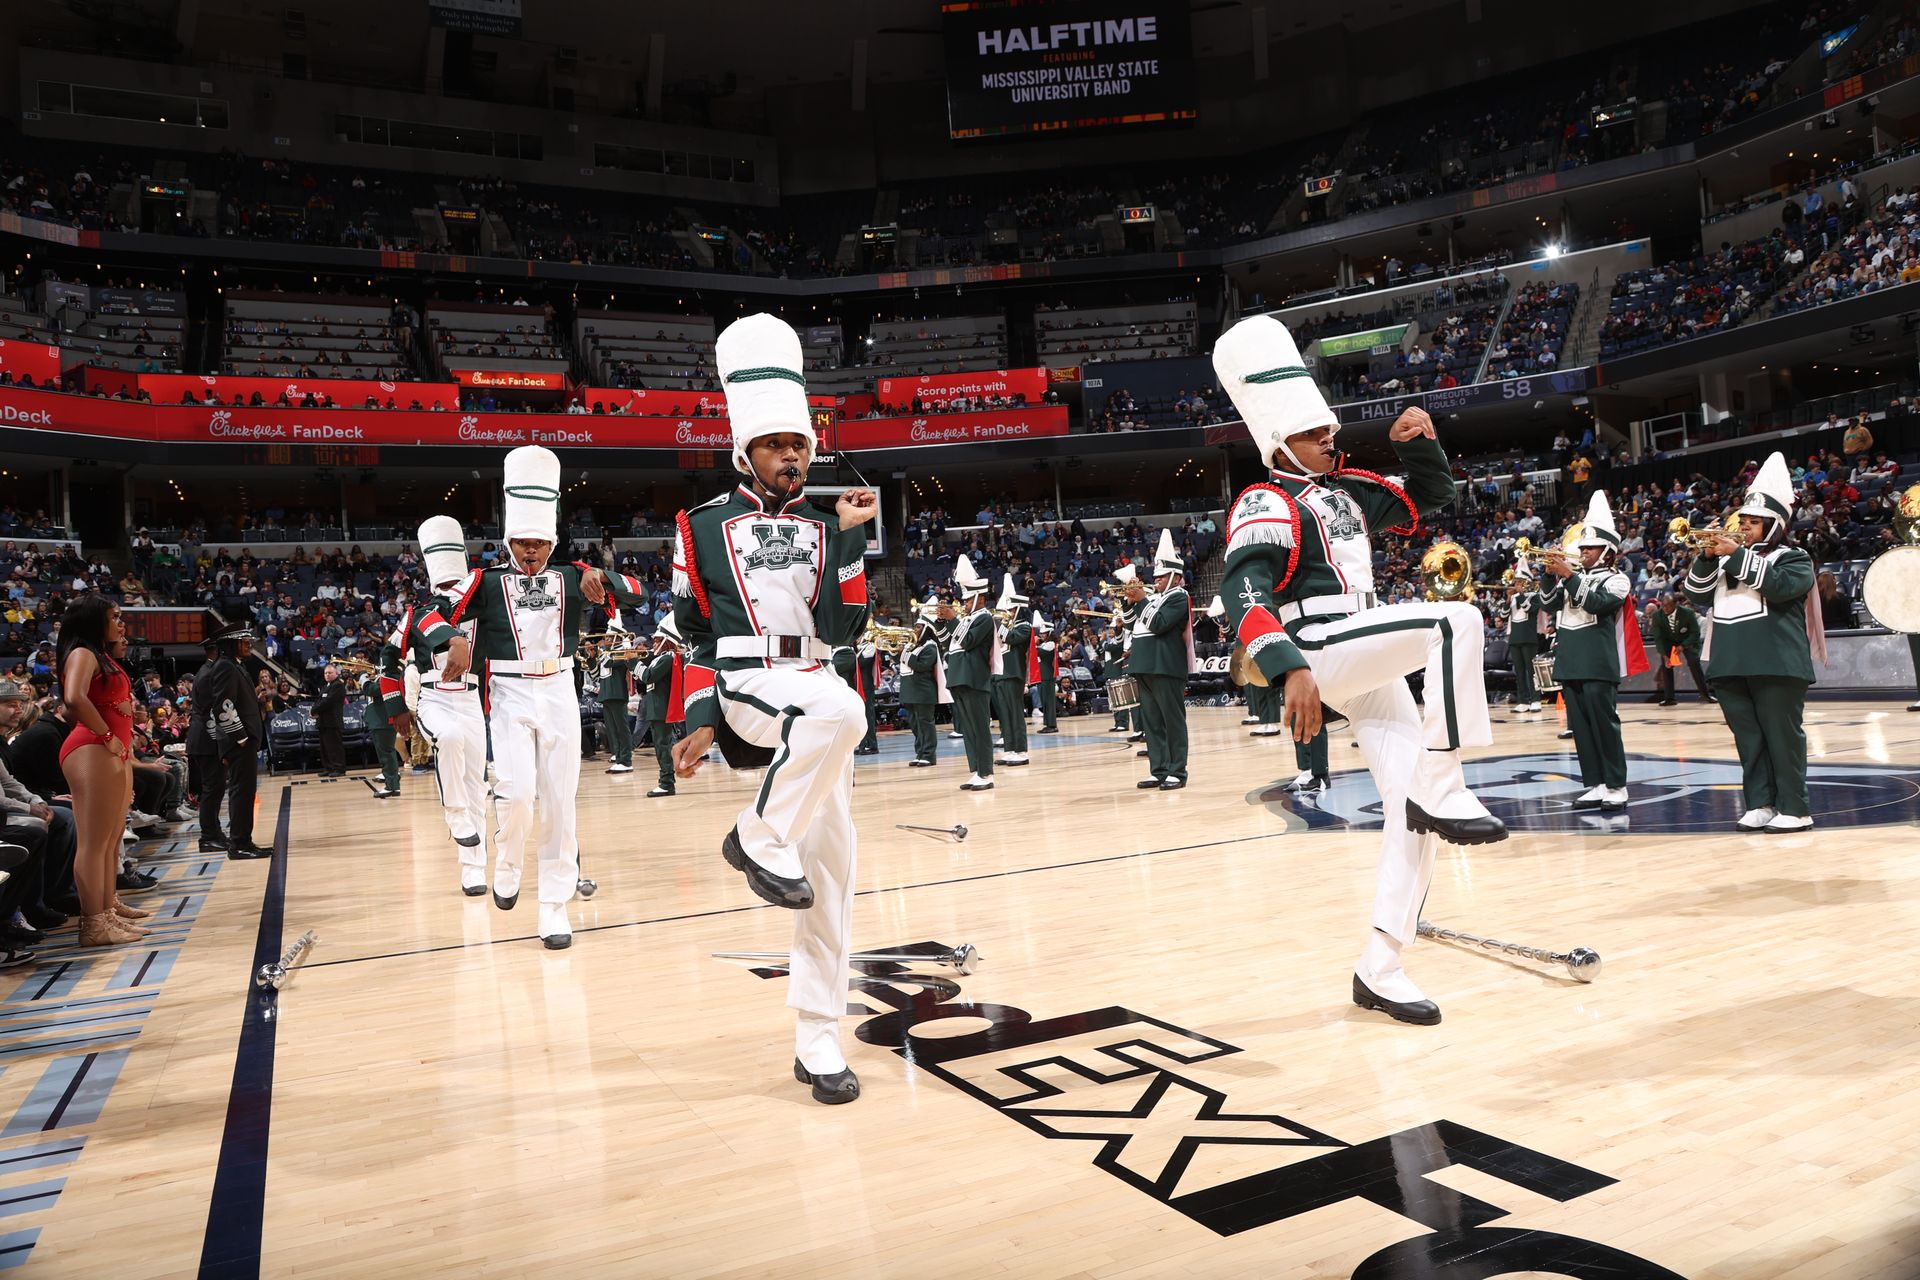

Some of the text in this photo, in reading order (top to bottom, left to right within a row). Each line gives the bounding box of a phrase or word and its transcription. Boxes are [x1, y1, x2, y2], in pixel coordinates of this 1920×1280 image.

[978, 16, 1157, 55] HALFTIME
[1043, 51, 1095, 63] FEATURING
[982, 60, 1159, 88] MISSISSIPPI VALLEY STATE
[1012, 80, 1131, 103] UNIVERSITY BAND
[1334, 331, 1401, 352] OrthoSouth
[508, 377, 546, 386] FanDeck
[917, 382, 1006, 397] Score points with
[1503, 381, 1531, 398] 58
[1428, 388, 1480, 403] TIMEOUTS: 5
[1429, 399, 1458, 410] FOULS:
[0, 405, 52, 425] Deck
[1361, 401, 1404, 420] HALF
[209, 411, 363, 439] Chick-fil-A FanDeck
[458, 416, 592, 443] Chick-fil-A FanDeck
[911, 419, 1029, 441] Chick-fil-A FanDeck
